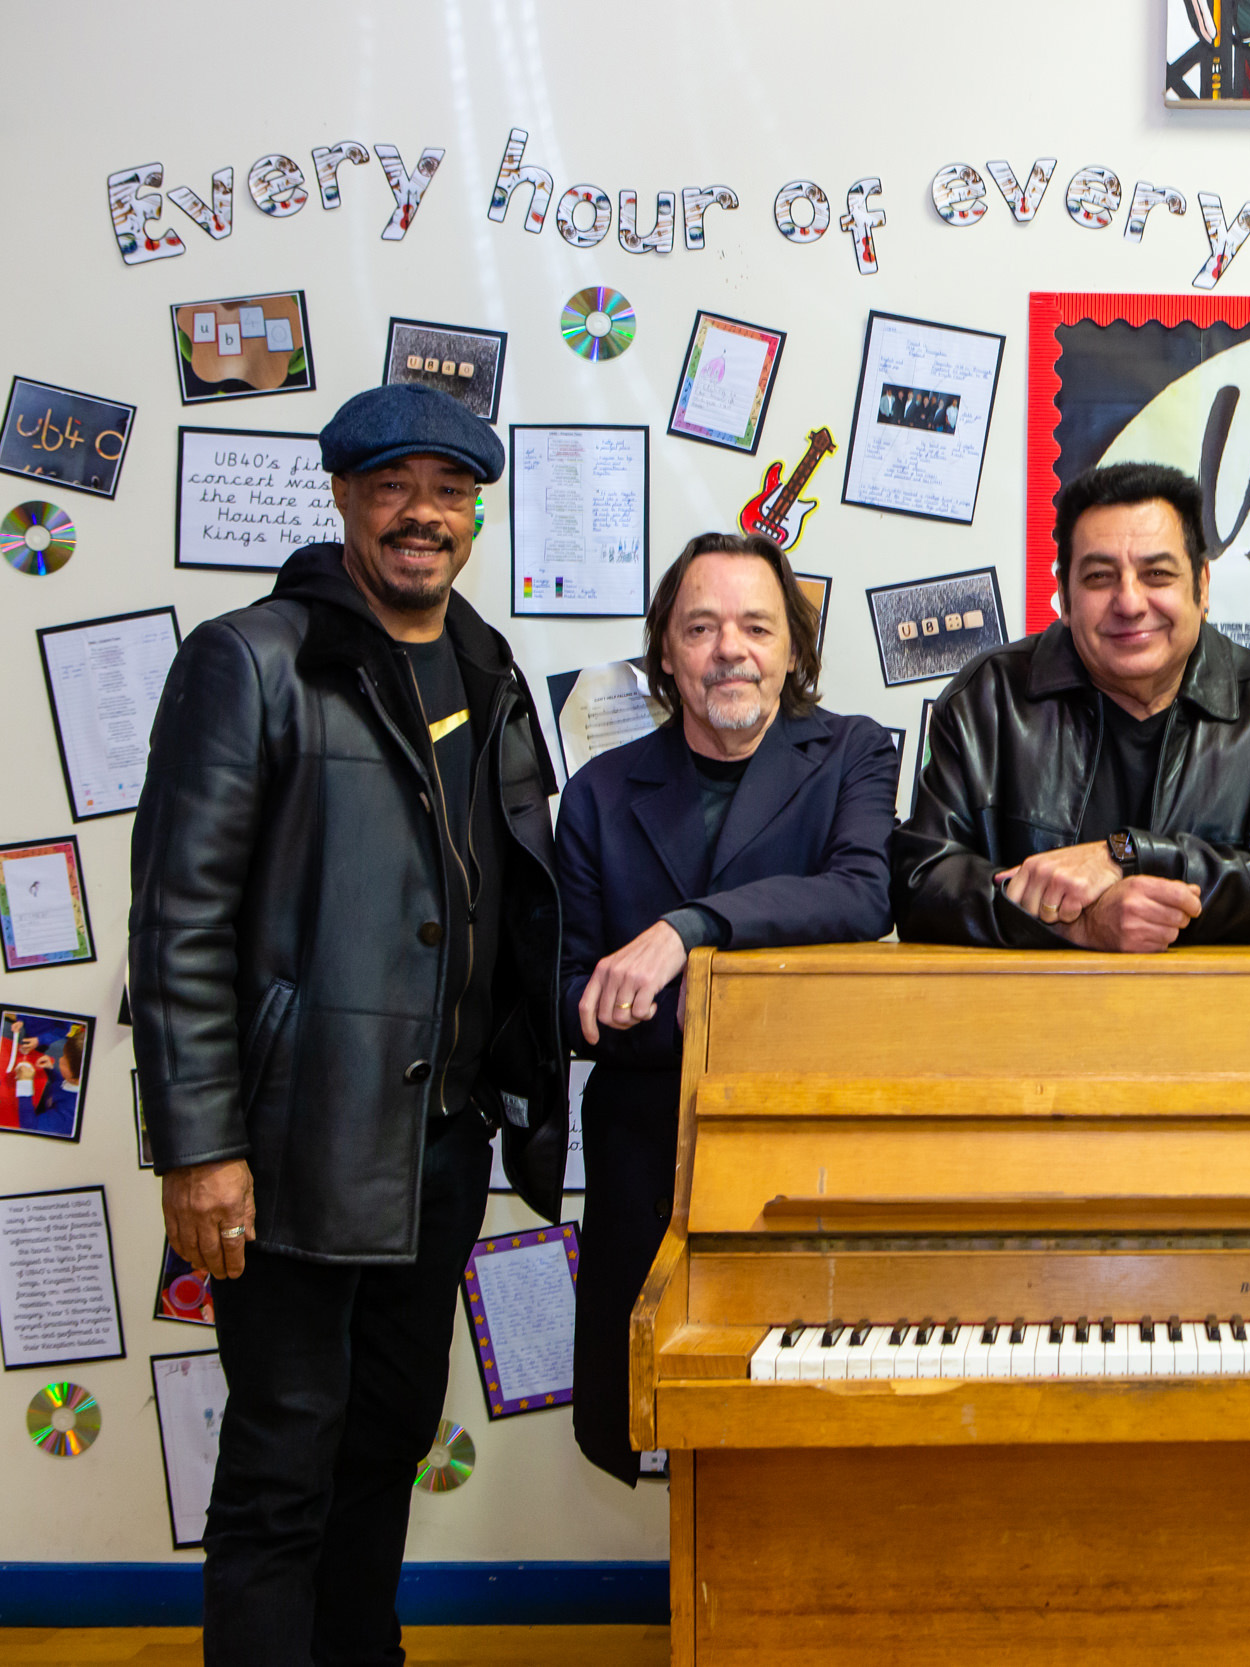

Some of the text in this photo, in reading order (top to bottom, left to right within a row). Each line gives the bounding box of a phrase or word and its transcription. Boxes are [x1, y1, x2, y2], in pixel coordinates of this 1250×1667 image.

[106, 140, 447, 266] Every
[487, 127, 740, 254] hour
[772, 176, 888, 276] of
[214, 451, 280, 470] UB40's
[188, 473, 331, 490] concert was
[199, 488, 337, 510] the Hare an
[217, 507, 337, 528] Hounds in
[202, 525, 267, 547] Kings
